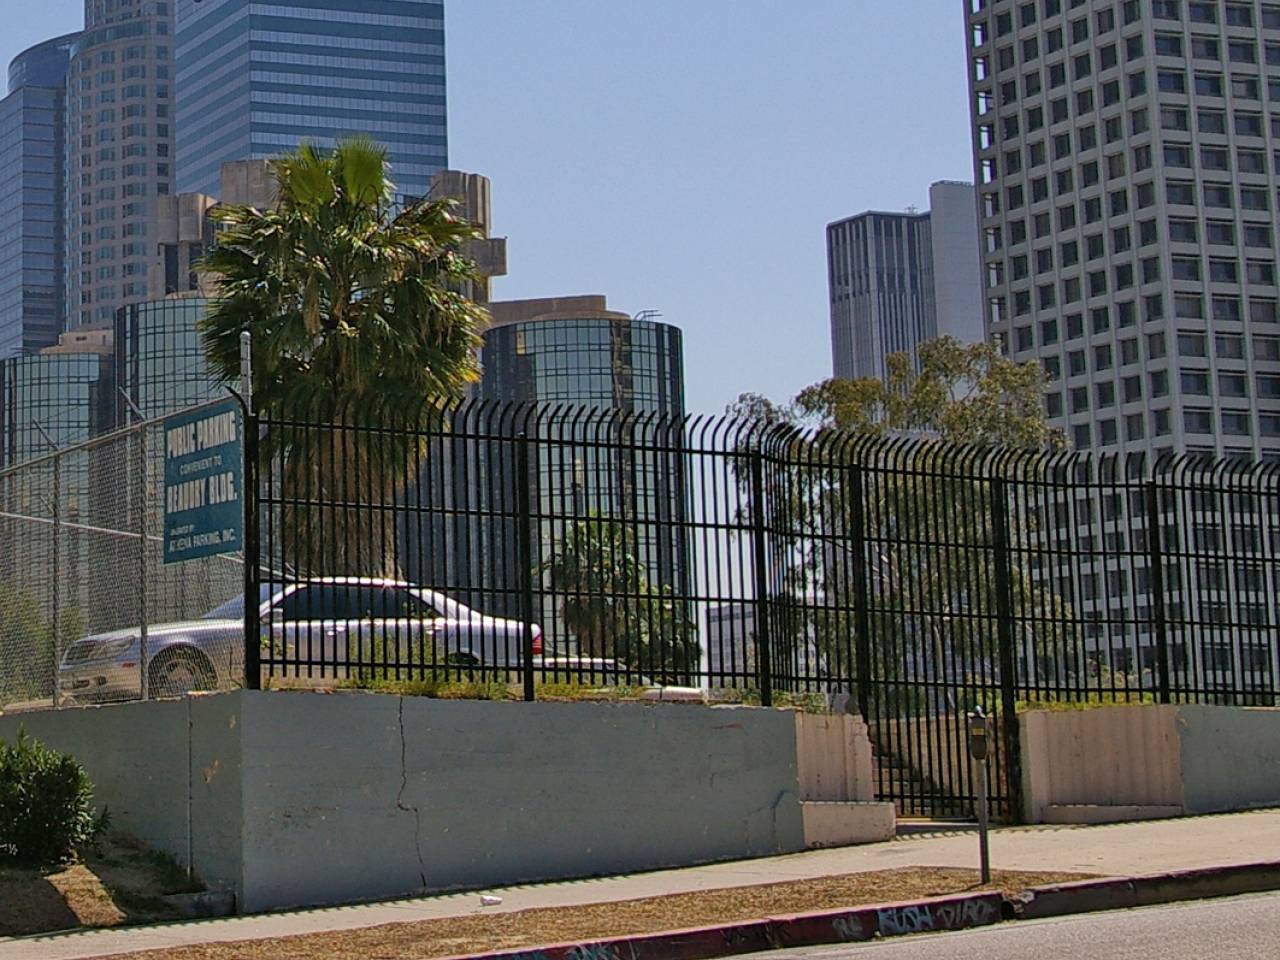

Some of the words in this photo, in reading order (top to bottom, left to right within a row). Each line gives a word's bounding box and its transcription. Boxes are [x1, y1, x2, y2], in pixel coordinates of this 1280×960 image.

[166, 422, 196, 459] PUBLIC
[196, 410, 236, 451] PARKING
[208, 471, 238, 505] BLDG.
